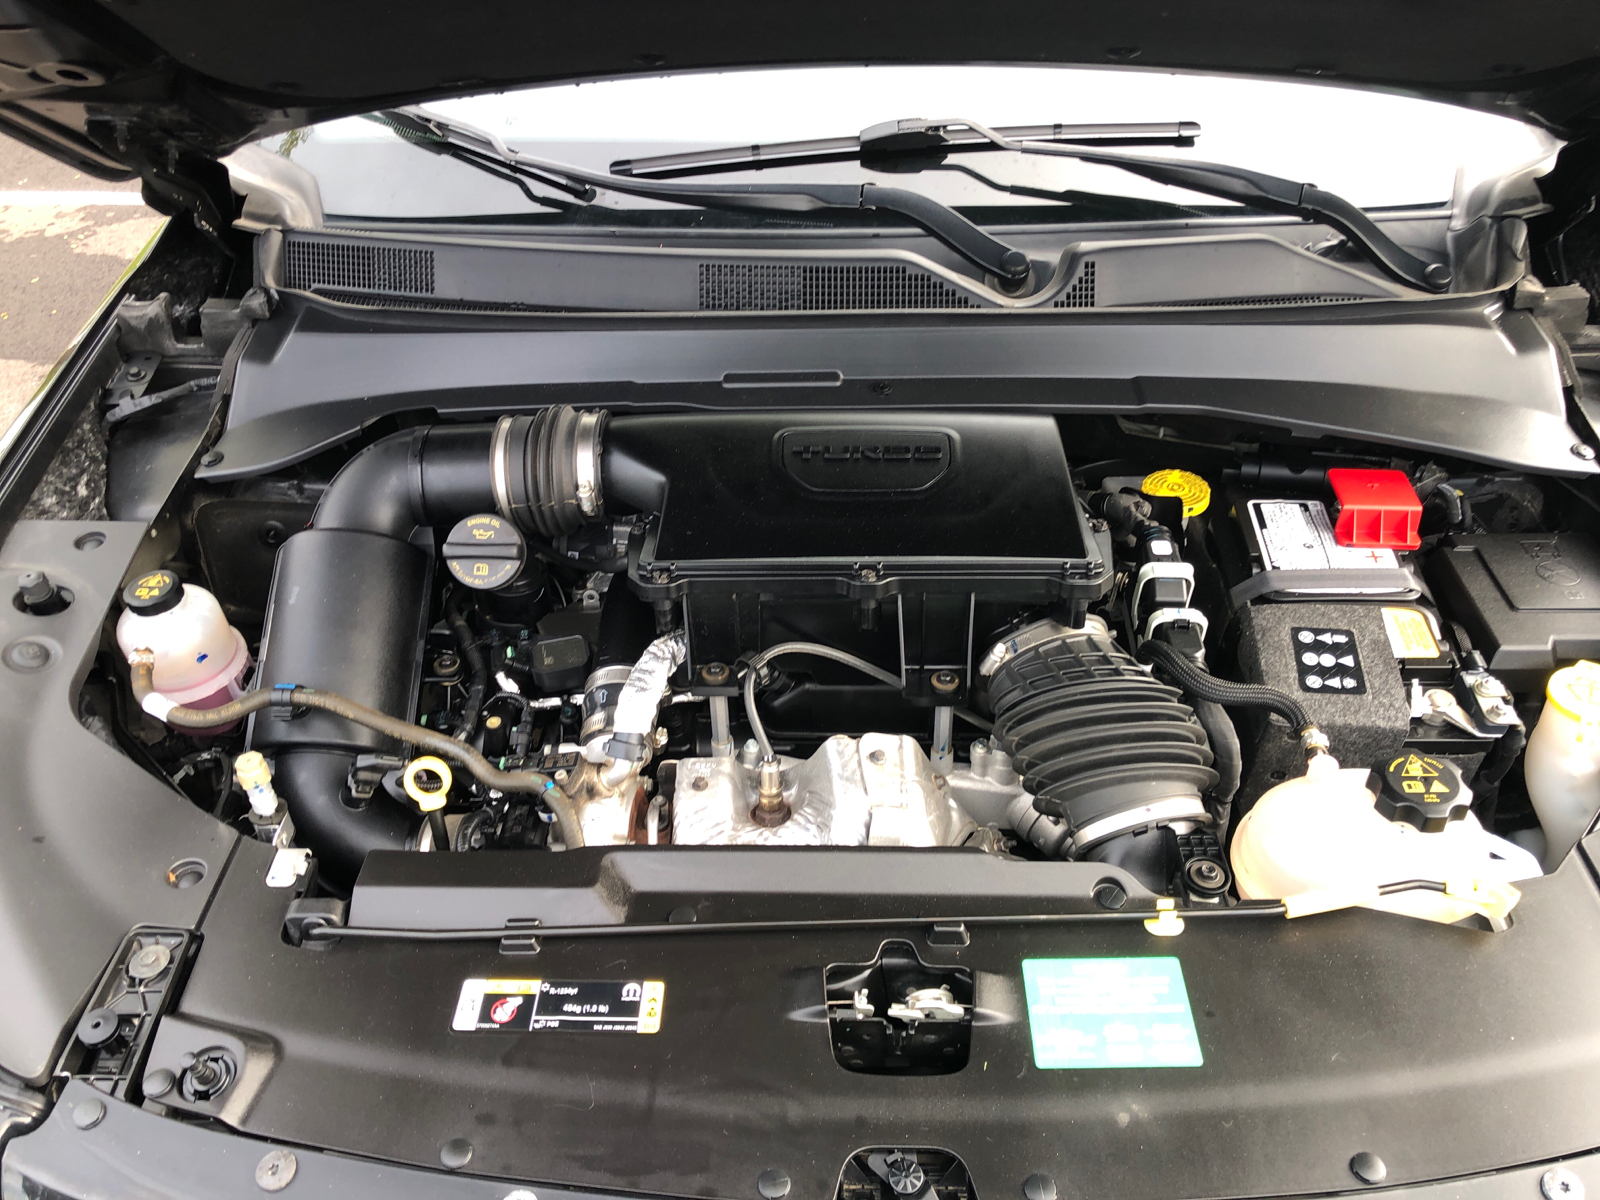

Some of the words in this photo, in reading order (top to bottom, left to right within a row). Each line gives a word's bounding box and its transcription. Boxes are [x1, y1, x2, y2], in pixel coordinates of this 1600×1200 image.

[791, 444, 943, 460] TURBO
[467, 517, 490, 527] ENGINE
[491, 518, 500, 529] OIL
[598, 1004, 609, 1014] lb)
